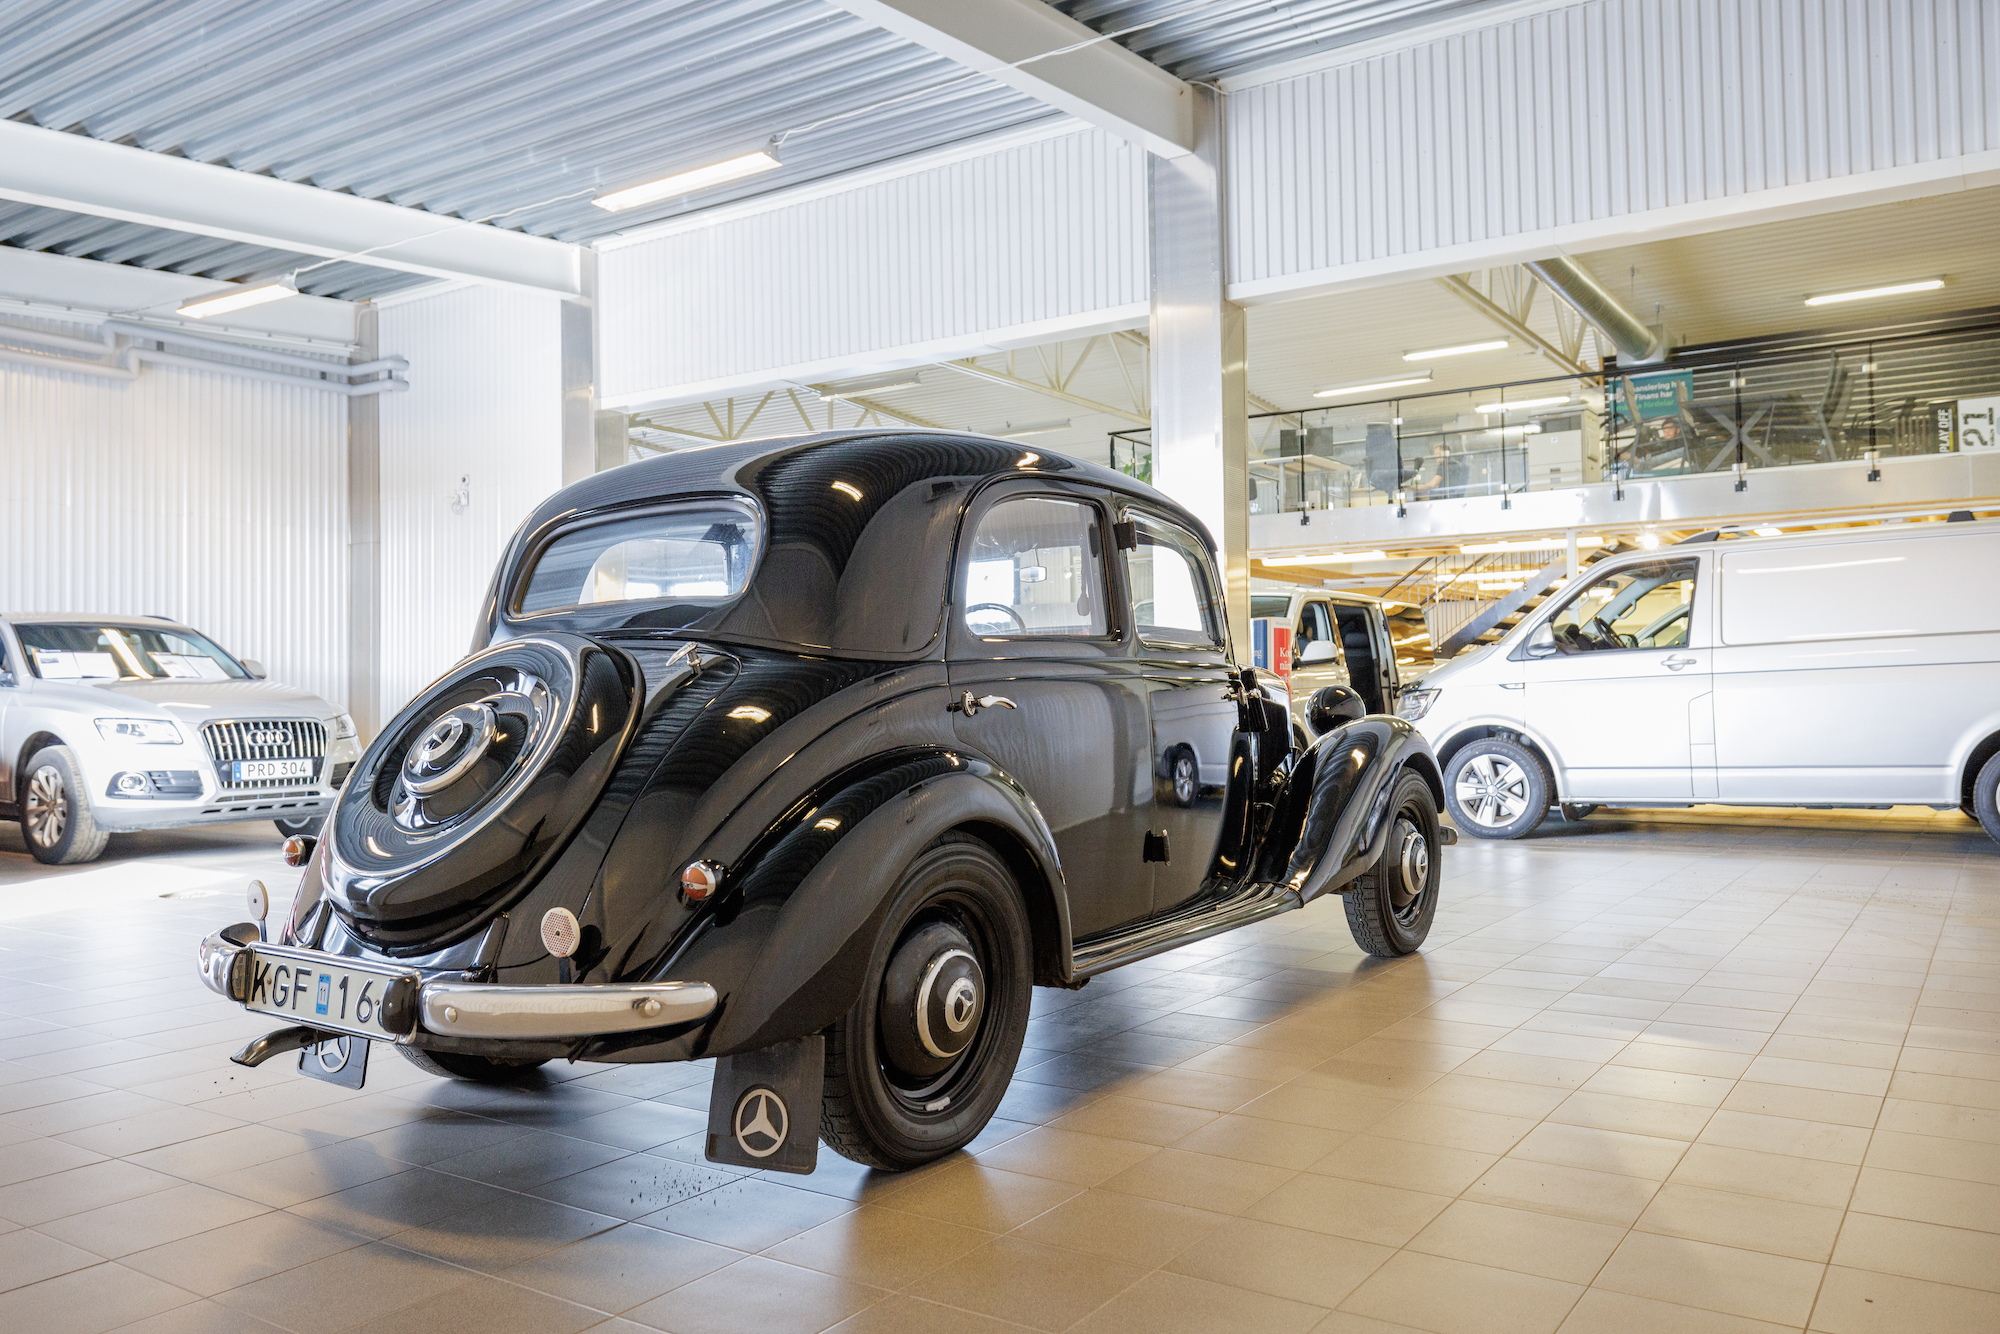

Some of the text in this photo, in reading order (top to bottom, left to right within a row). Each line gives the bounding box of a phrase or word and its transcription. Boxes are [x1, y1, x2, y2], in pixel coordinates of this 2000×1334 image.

[1671, 380, 1686, 388] hs
[1635, 391, 1659, 401] Finans
[1660, 390, 1674, 398] har
[1937, 408, 1950, 453] PLAY OFF
[247, 761, 307, 777] PRD 304
[251, 960, 385, 1029] KGF 16
